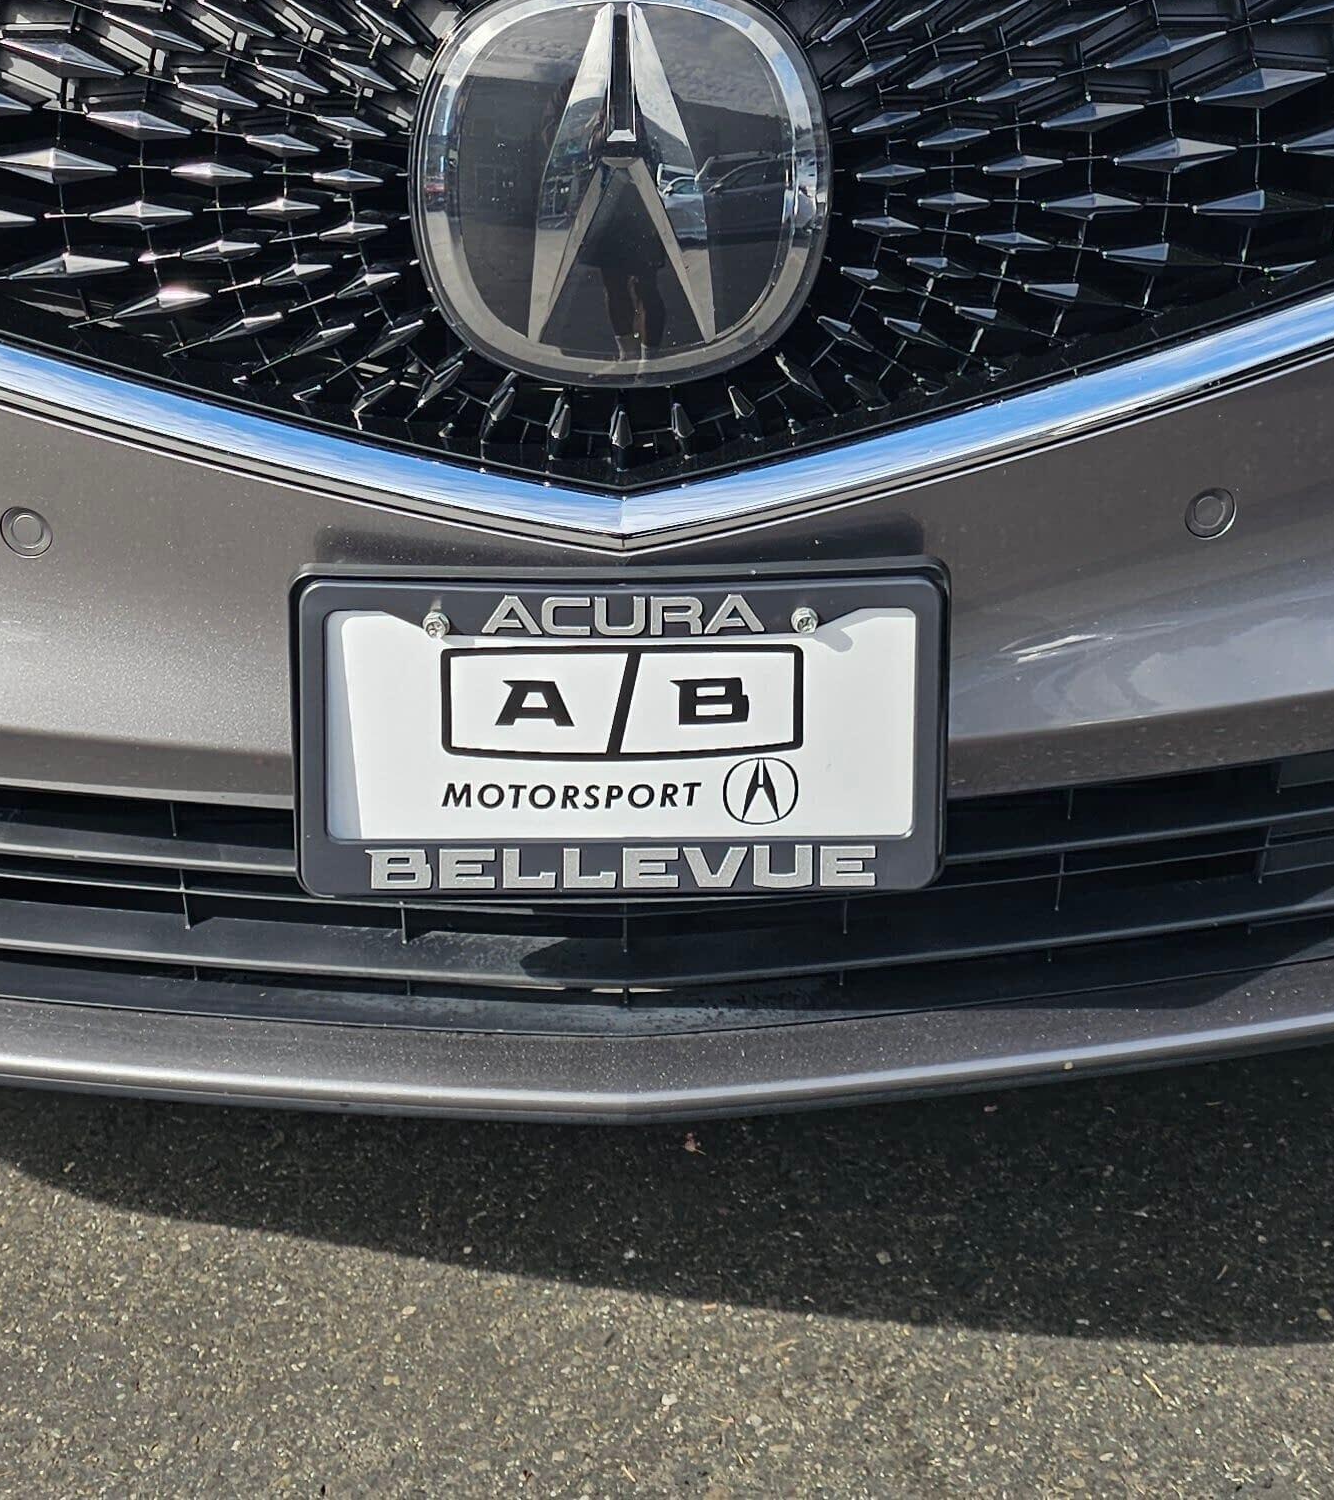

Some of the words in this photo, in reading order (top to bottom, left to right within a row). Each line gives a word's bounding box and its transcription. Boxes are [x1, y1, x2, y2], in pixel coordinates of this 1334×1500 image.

[481, 594, 765, 636] ACURA
[441, 781, 702, 811] MOTORSPORT
[365, 845, 877, 891] BELLEVUE
